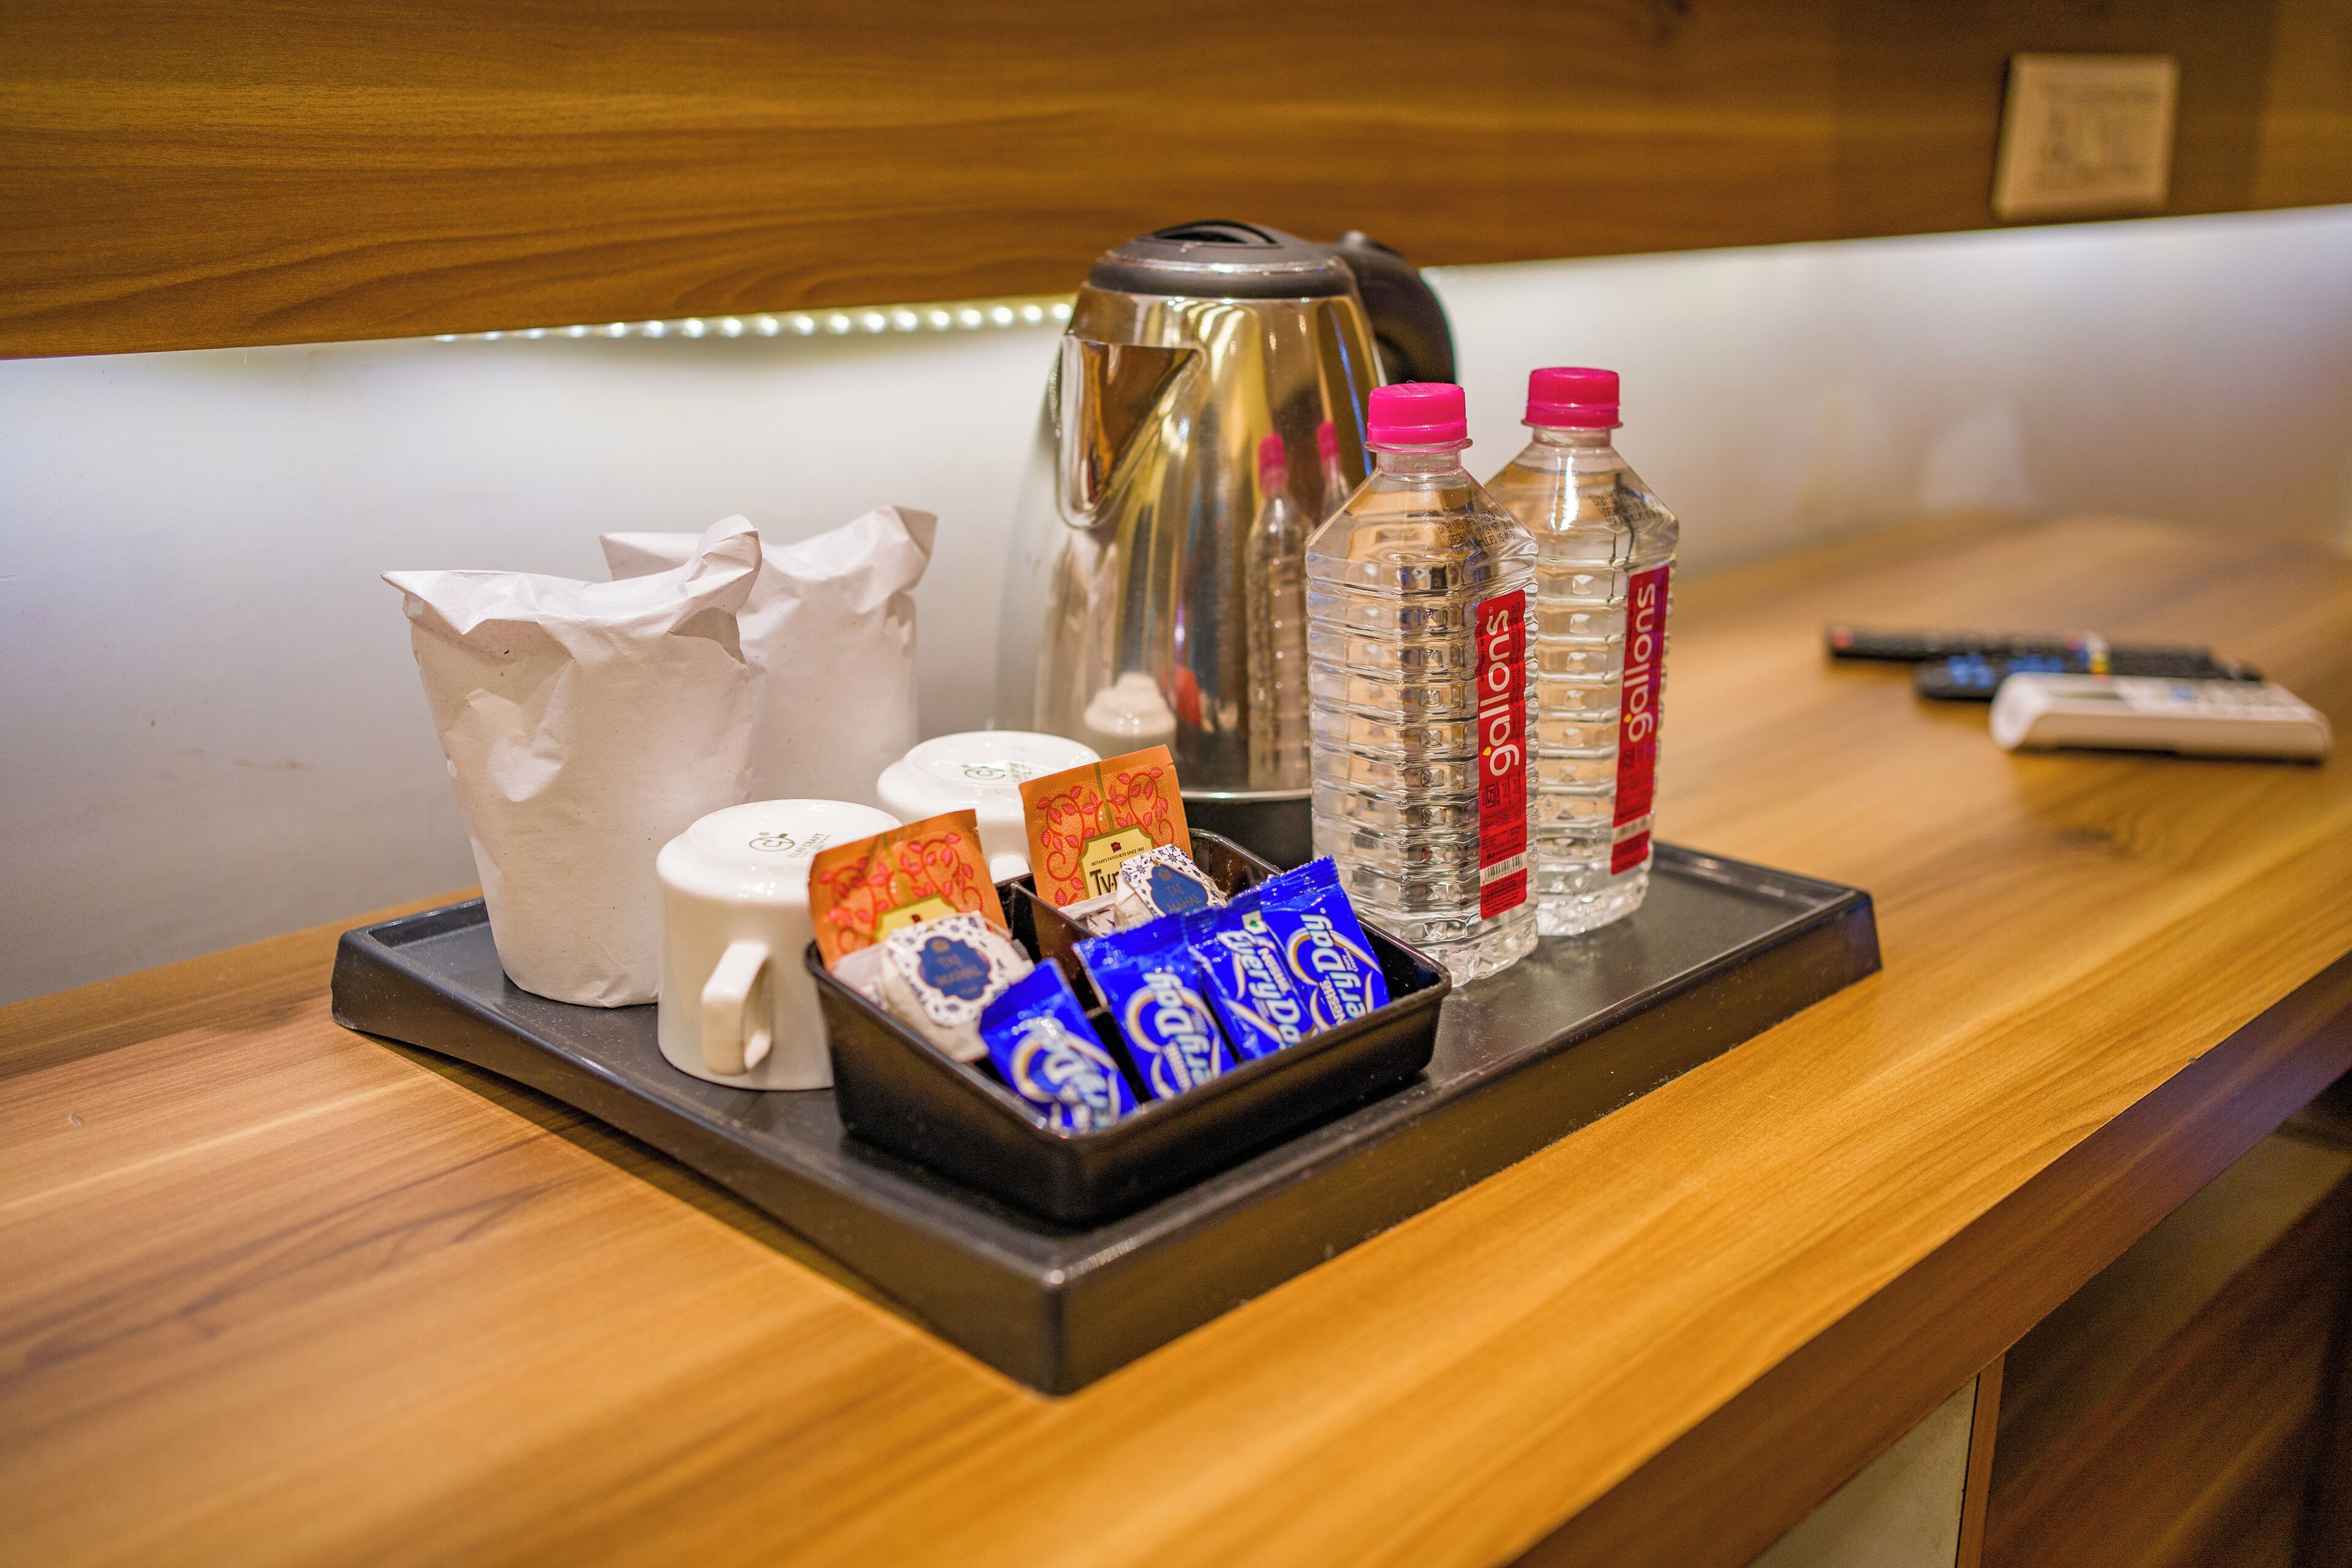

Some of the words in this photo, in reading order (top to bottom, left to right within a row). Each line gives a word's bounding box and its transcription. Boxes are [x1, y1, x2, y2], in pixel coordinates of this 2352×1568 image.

[1479, 609, 1520, 777] gallons
[1623, 583, 1656, 743] gallons
[1091, 858, 1107, 867] BRITAIN'S
[1107, 852, 1126, 861] FAVOURITE
[1216, 929, 1302, 1050] EveryDa
[1299, 913, 1368, 1019] eryDay
